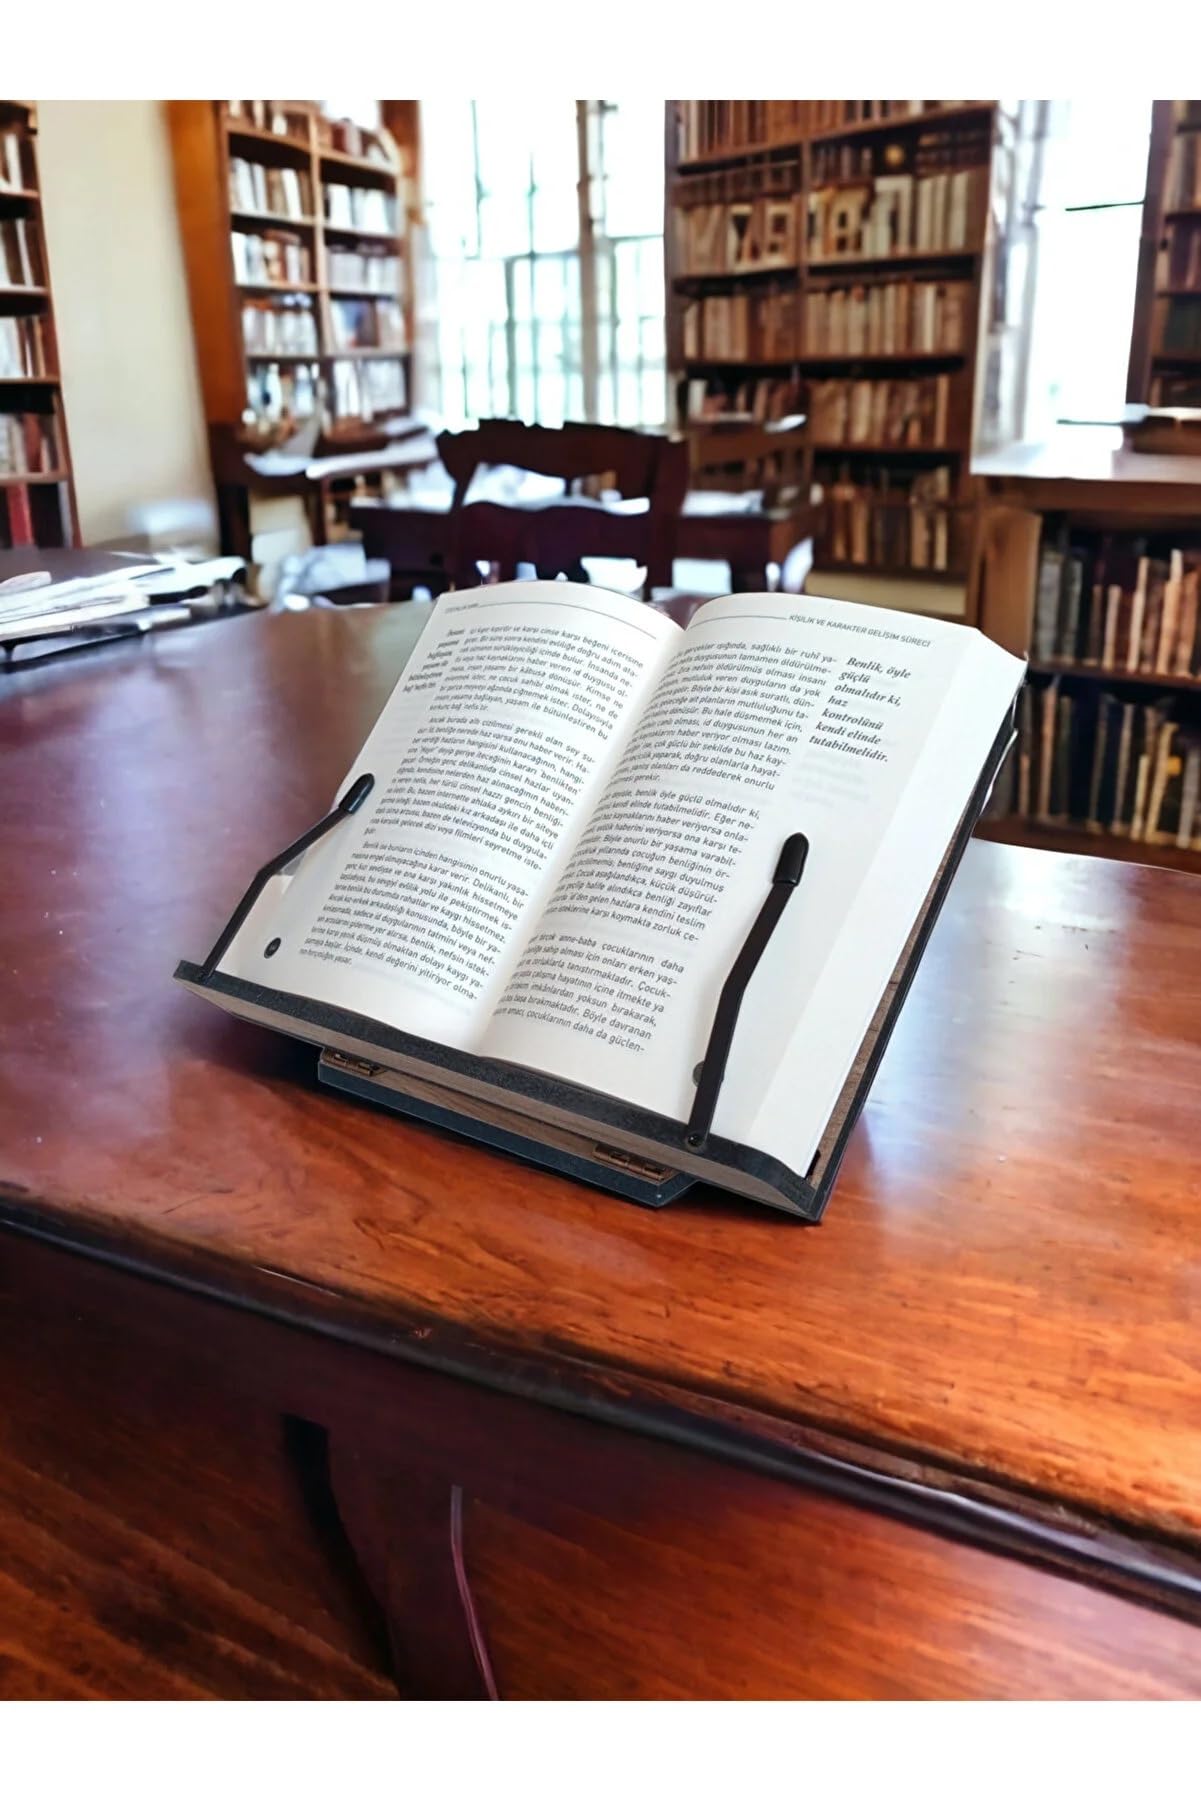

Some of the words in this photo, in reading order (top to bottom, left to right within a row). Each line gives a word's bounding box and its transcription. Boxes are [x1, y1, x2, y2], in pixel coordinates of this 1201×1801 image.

[816, 618, 826, 626] VE
[826, 621, 867, 634] KARAKTER
[582, 636, 609, 651] beğeni
[784, 647, 798, 655] bir
[562, 653, 584, 664] bulur.
[620, 678, 632, 687] ne-
[577, 647, 600, 660] doğru
[601, 657, 621, 669] adım
[739, 653, 779, 664] tamamen
[846, 657, 883, 673] Benlik,
[886, 667, 911, 678] öyle
[549, 662, 571, 672] veren
[582, 672, 615, 691] duygusu
[740, 676, 786, 690] duyguların
[790, 684, 801, 693] da
[803, 688, 821, 697] yok
[765, 668, 796, 680] olması
[798, 673, 826, 686] insanı
[838, 672, 871, 683] güçlü
[545, 684, 569, 696] olmak
[596, 704, 606, 712] ne
[608, 710, 618, 719] de
[586, 685, 611, 702] Kimse
[613, 700, 623, 709] ne
[712, 685, 725, 693] bir
[793, 698, 814, 707] dün-
[828, 695, 848, 707] haz
[834, 684, 886, 701] olmalıdır
[887, 695, 901, 706] ki,
[531, 702, 541, 710] ile
[598, 729, 608, 740] bu
[701, 707, 713, 715] Bu
[714, 708, 732, 717] hale
[737, 700, 794, 717] mutluluğunu
[795, 710, 808, 719] ta-
[821, 708, 884, 730] kontrolünü
[514, 726, 543, 739] gerekli
[545, 737, 563, 748] olan
[582, 754, 595, 763] su-
[701, 732, 731, 741] veriyor
[732, 735, 762, 748] olması
[764, 741, 791, 755] lazım.
[713, 720, 765, 735] duygusunun
[767, 729, 784, 739] her
[786, 735, 798, 743] an
[816, 721, 847, 736] kendi
[847, 730, 881, 744] elinde
[513, 738, 528, 747] onu
[529, 741, 553, 755] haber
[554, 752, 573, 764] verir.
[576, 762, 589, 773] Ha-
[689, 740, 702, 749] bir
[734, 747, 746, 757] bu
[748, 750, 765, 761] haz
[766, 754, 786, 767] kay-
[809, 736, 887, 762] tutabilmelidir.
[512, 760, 537, 775] kararı
[560, 767, 584, 784] hangi-
[680, 764, 691, 772] da
[692, 767, 742, 782] reddederek
[744, 778, 775, 790] onurlu
[684, 752, 709, 763] doğru
[710, 756, 750, 771] olanlarla
[750, 764, 780, 777] hayat-
[491, 779, 538, 801] alınacağının
[540, 797, 568, 816] haberi-
[498, 769, 523, 782] cinsel
[524, 777, 551, 792] hazlar
[552, 791, 574, 805] uyan-
[504, 796, 531, 811] gencin
[635, 788, 657, 797] benlik
[659, 791, 676, 800] öyle
[705, 798, 747, 813] olmalıdır
[749, 809, 759, 820] ki,
[652, 802, 710, 819] tutabilmelidir.
[714, 813, 737, 825] Eğer
[738, 821, 754, 829] ne-
[497, 807, 521, 819] aykırı
[522, 814, 534, 825] bir
[535, 823, 558, 839] siteye
[507, 822, 518, 832] ile
[520, 828, 540, 842] daha
[655, 814, 681, 824] haber
[682, 820, 722, 835] veriyorsa
[724, 831, 748, 841] onla-
[484, 840, 522, 861] seyretme
[500, 832, 511, 842] bu
[513, 838, 547, 859] duygula-
[623, 836, 649, 845] onurlu
[650, 839, 663, 848] bir
[701, 852, 736, 865] varabil-
[645, 827, 682, 839] veriyorsa
[684, 834, 701, 843] ona
[729, 845, 742, 853] te-
[632, 850, 666, 862] çocuğun
[668, 856, 712, 874] benliğinin
[428, 863, 449, 875] karar
[450, 872, 469, 883] verir.
[512, 897, 524, 909] bir
[479, 869, 506, 886] onurlu
[616, 859, 653, 873] benliğine
[655, 868, 677, 879] saygı
[679, 873, 724, 893] duyulmuş
[437, 881, 469, 896] yakınlık
[472, 891, 518, 920] hissetmeye
[438, 892, 448, 902] ile
[607, 884, 643, 897] alındıkça
[645, 891, 676, 906] benliği
[677, 902, 712, 916] zayıflar
[430, 904, 439, 912] ve
[462, 915, 505, 944] hissetmez.
[610, 897, 641, 911] hazlara
[642, 904, 676, 919] kendini
[676, 914, 705, 930] teslim
[611, 911, 651, 928] koymakta
[652, 923, 682, 936] zorluk
[427, 929, 457, 946] tatmini
[458, 943, 477, 956] veya
[451, 924, 473, 940] böyle
[475, 935, 488, 946] bir
[486, 944, 500, 952] ya-
[383, 941, 418, 958] olmaktan
[420, 954, 445, 969] dolayı
[446, 965, 469, 981] kaygı
[469, 978, 483, 988] ya-
[438, 948, 464, 964] nefsin
[602, 944, 654, 964] çocuklarının
[661, 960, 684, 973] daha
[602, 957, 628, 970] onları
[628, 965, 655, 978] erken
[418, 968, 452, 986] yitiriyor
[453, 984, 477, 999] olma-
[557, 973, 592, 989] hayatının
[616, 989, 652, 1008] itmekte
[651, 1003, 664, 1012] ya
[637, 981, 671, 998] Çocuk-
[576, 994, 607, 1008] yoksun
[611, 1003, 656, 1027] bırakarak,
[573, 1022, 594, 1035] daha
[596, 1029, 608, 1039] da
[608, 1035, 645, 1052] güçlen-
[582, 1009, 607, 1024] Böyle
[609, 1018, 652, 1039] davranan
